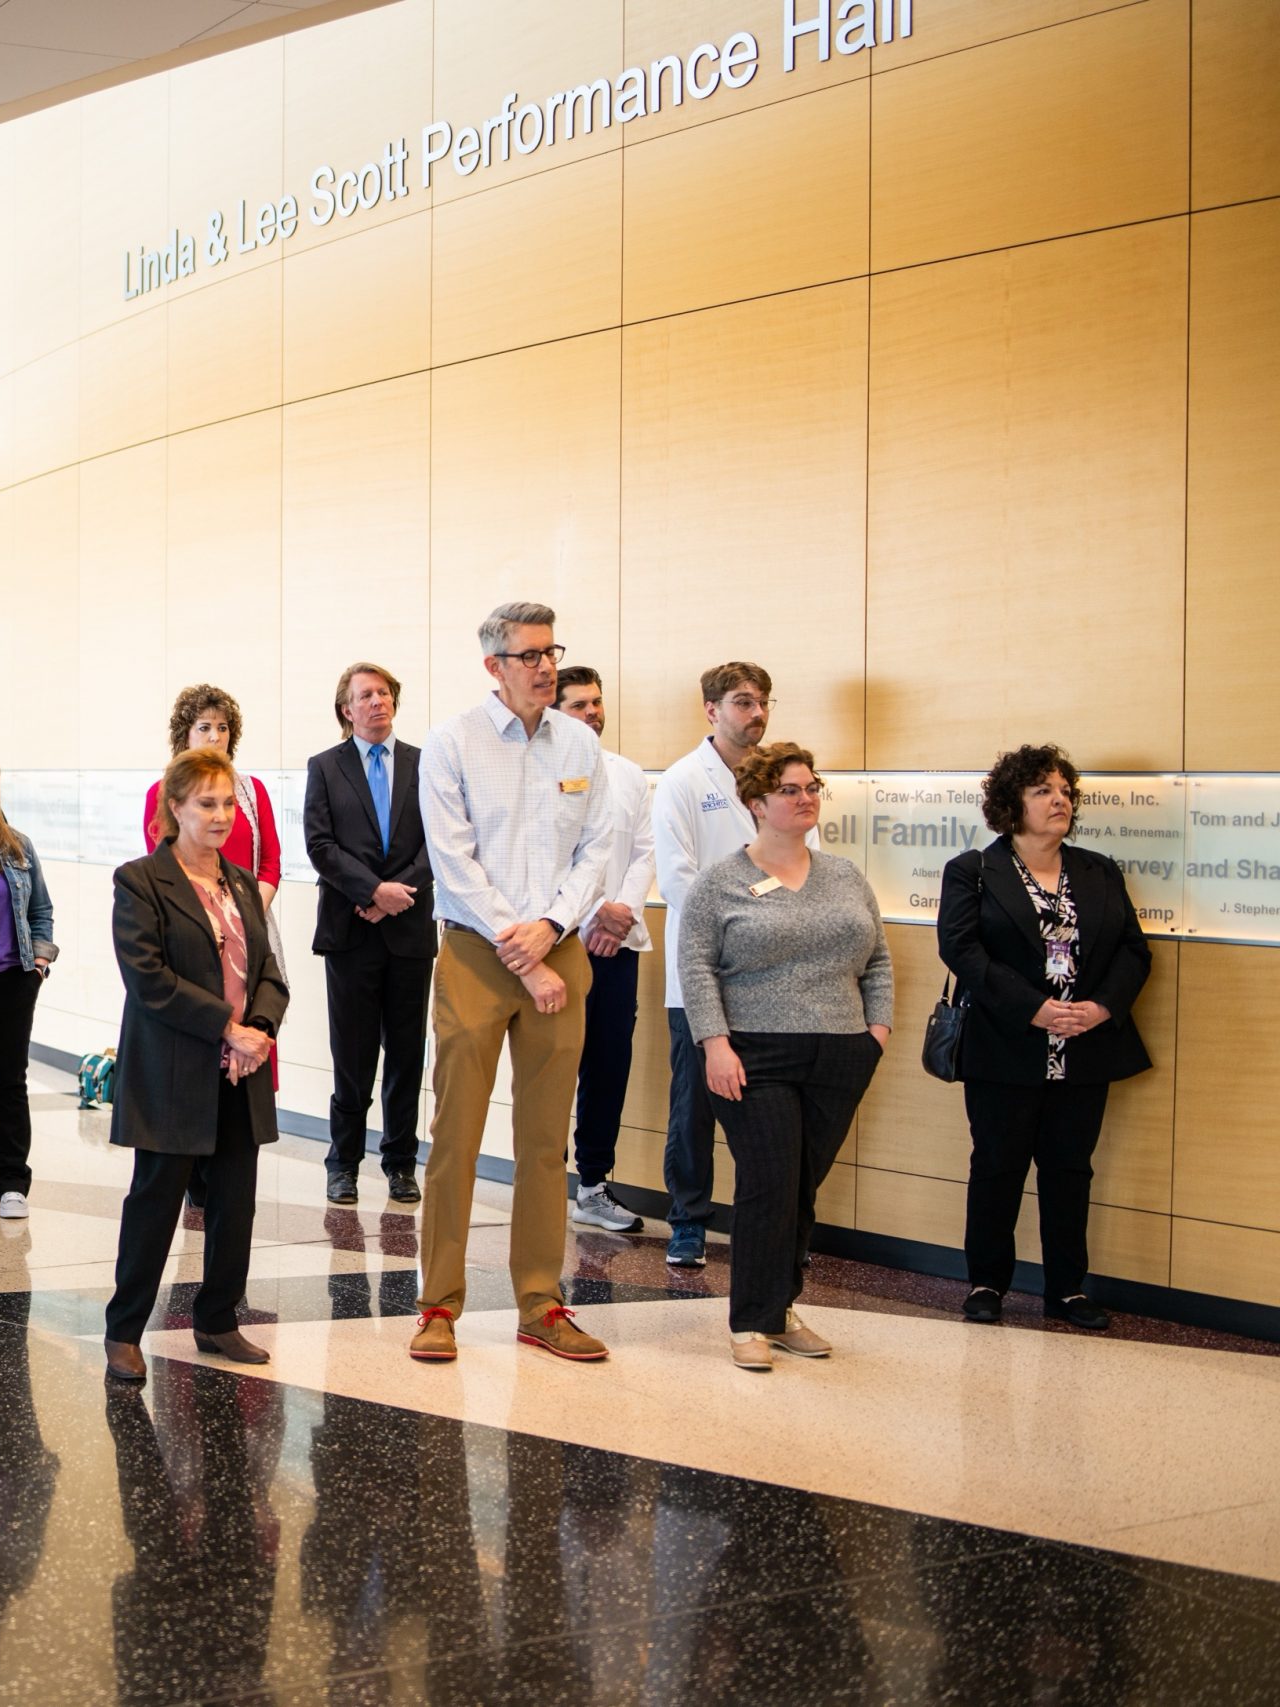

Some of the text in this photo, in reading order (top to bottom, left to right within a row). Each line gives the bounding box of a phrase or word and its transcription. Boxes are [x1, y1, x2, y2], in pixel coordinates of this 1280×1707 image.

[122, 228, 196, 301] Linda
[203, 209, 229, 268] &
[237, 193, 300, 255] Lee
[308, 137, 410, 227] Scott
[420, 31, 760, 189] Performance
[875, 789, 942, 804] Craw-Kan
[1130, 791, 1160, 806] Inc.
[1190, 810, 1227, 827] Tom
[1232, 811, 1265, 827] and
[817, 814, 978, 853] ell Family
[1074, 825, 1180, 839] Mary A. Breneman
[911, 867, 941, 879] Albert
[1109, 854, 1280, 881] arvey and Sha
[1134, 907, 1174, 924] amp
[1219, 902, 1231, 913] J.
